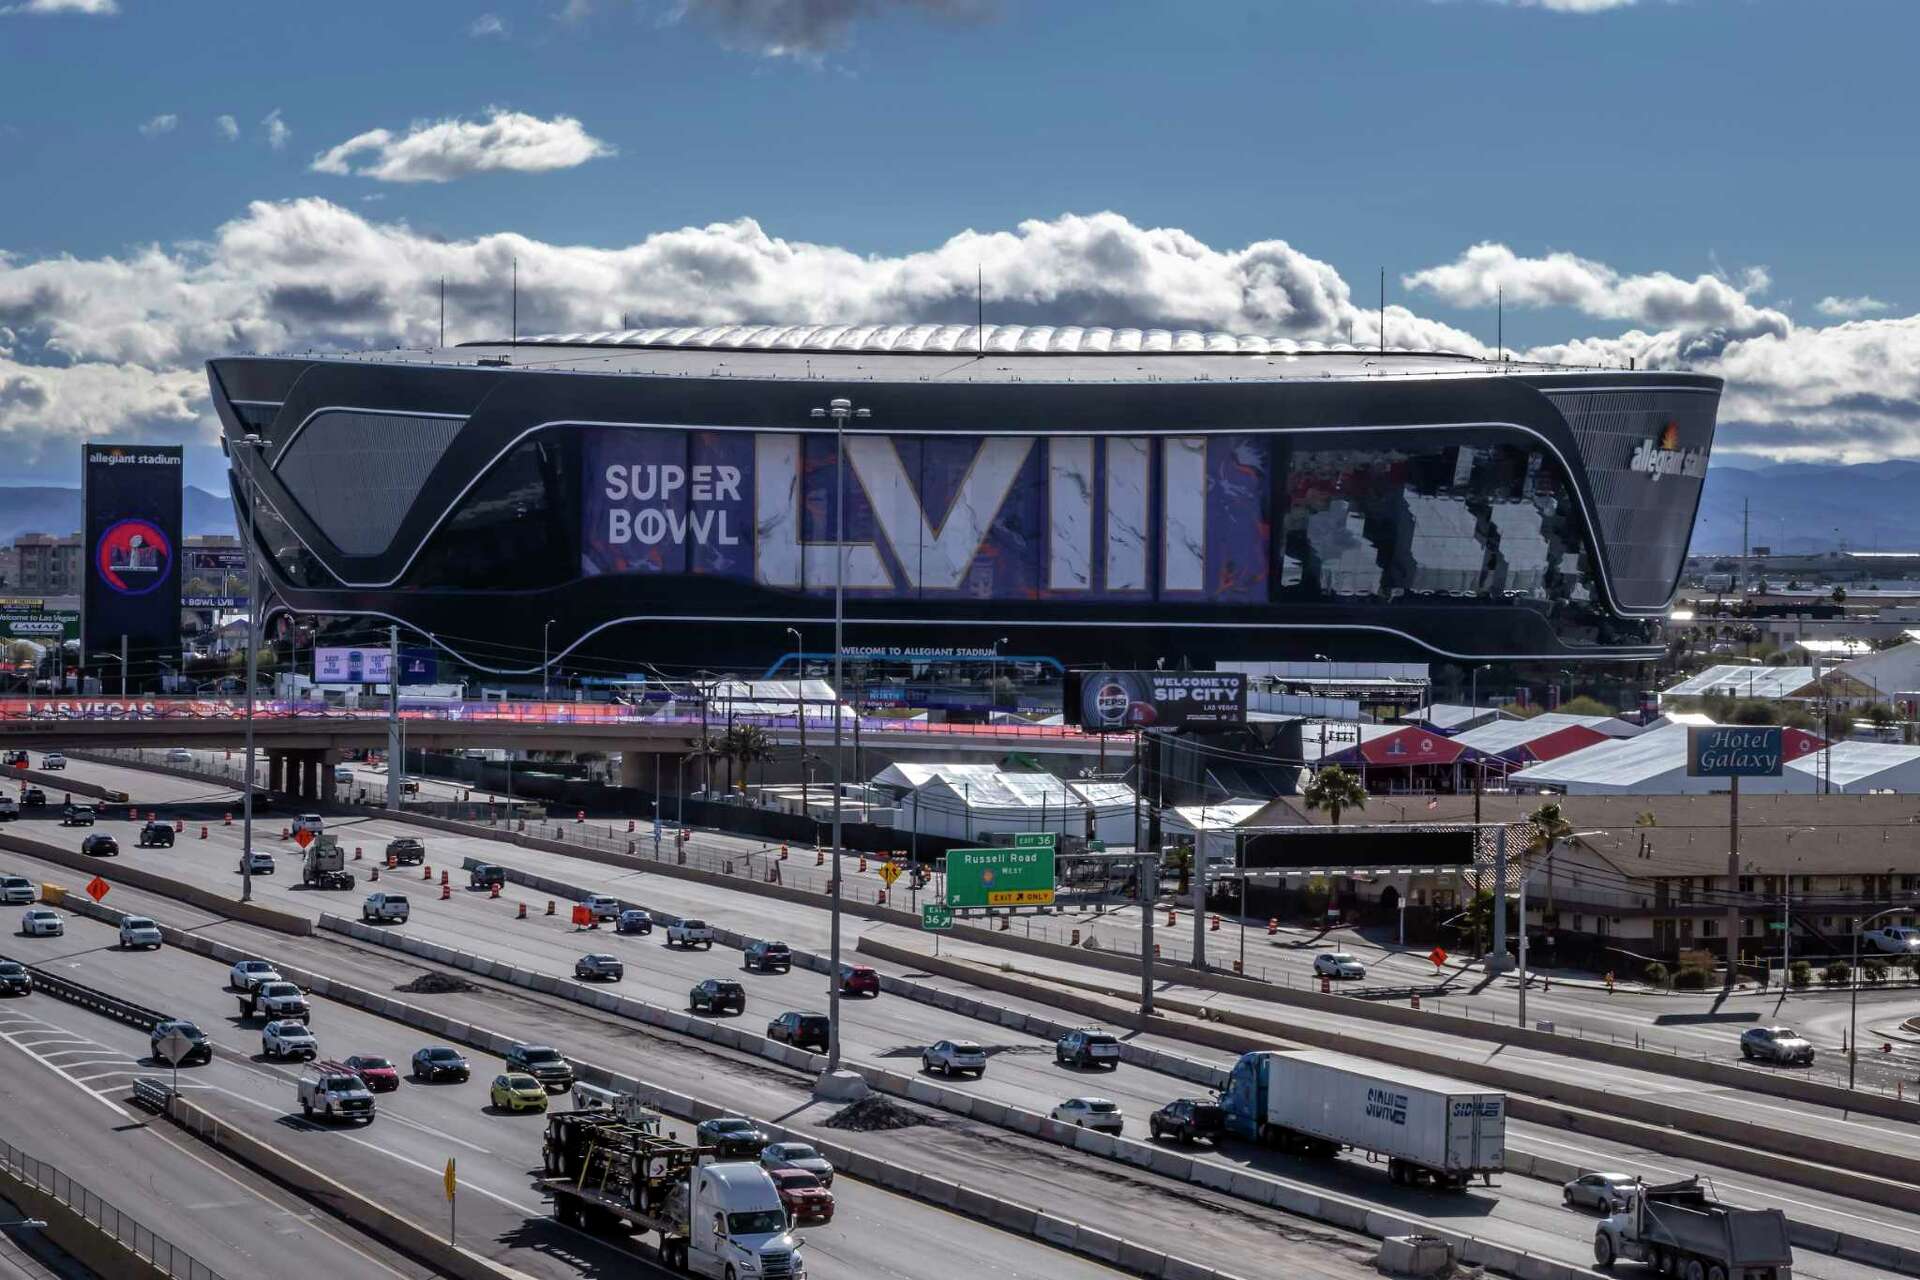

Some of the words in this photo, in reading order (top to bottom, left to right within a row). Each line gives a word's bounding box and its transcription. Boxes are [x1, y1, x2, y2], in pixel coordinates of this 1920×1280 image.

[90, 452, 136, 466] allegiant
[138, 453, 181, 465] stadium
[605, 464, 742, 502] SUPER
[755, 433, 1209, 590] LVIII
[608, 508, 739, 545] BOWL
[841, 647, 886, 656] WELCOME
[890, 648, 901, 656] TO
[904, 648, 953, 656] ALLEGIANT
[956, 648, 998, 657] STADIUM
[1153, 678, 1220, 687] WELCOME
[1221, 678, 1240, 687] TO
[1154, 688, 1188, 701] SIP
[1191, 688, 1240, 701] CITY
[1099, 698, 1127, 707] PEPSI
[76, 702, 155, 720] VEGAS
[1709, 729, 1775, 749] Hotel
[1701, 750, 1777, 773] Galaxy
[1038, 836, 1051, 845] 36
[964, 854, 1005, 864] Russell
[1010, 853, 1037, 862] Road
[925, 915, 939, 924] 36
